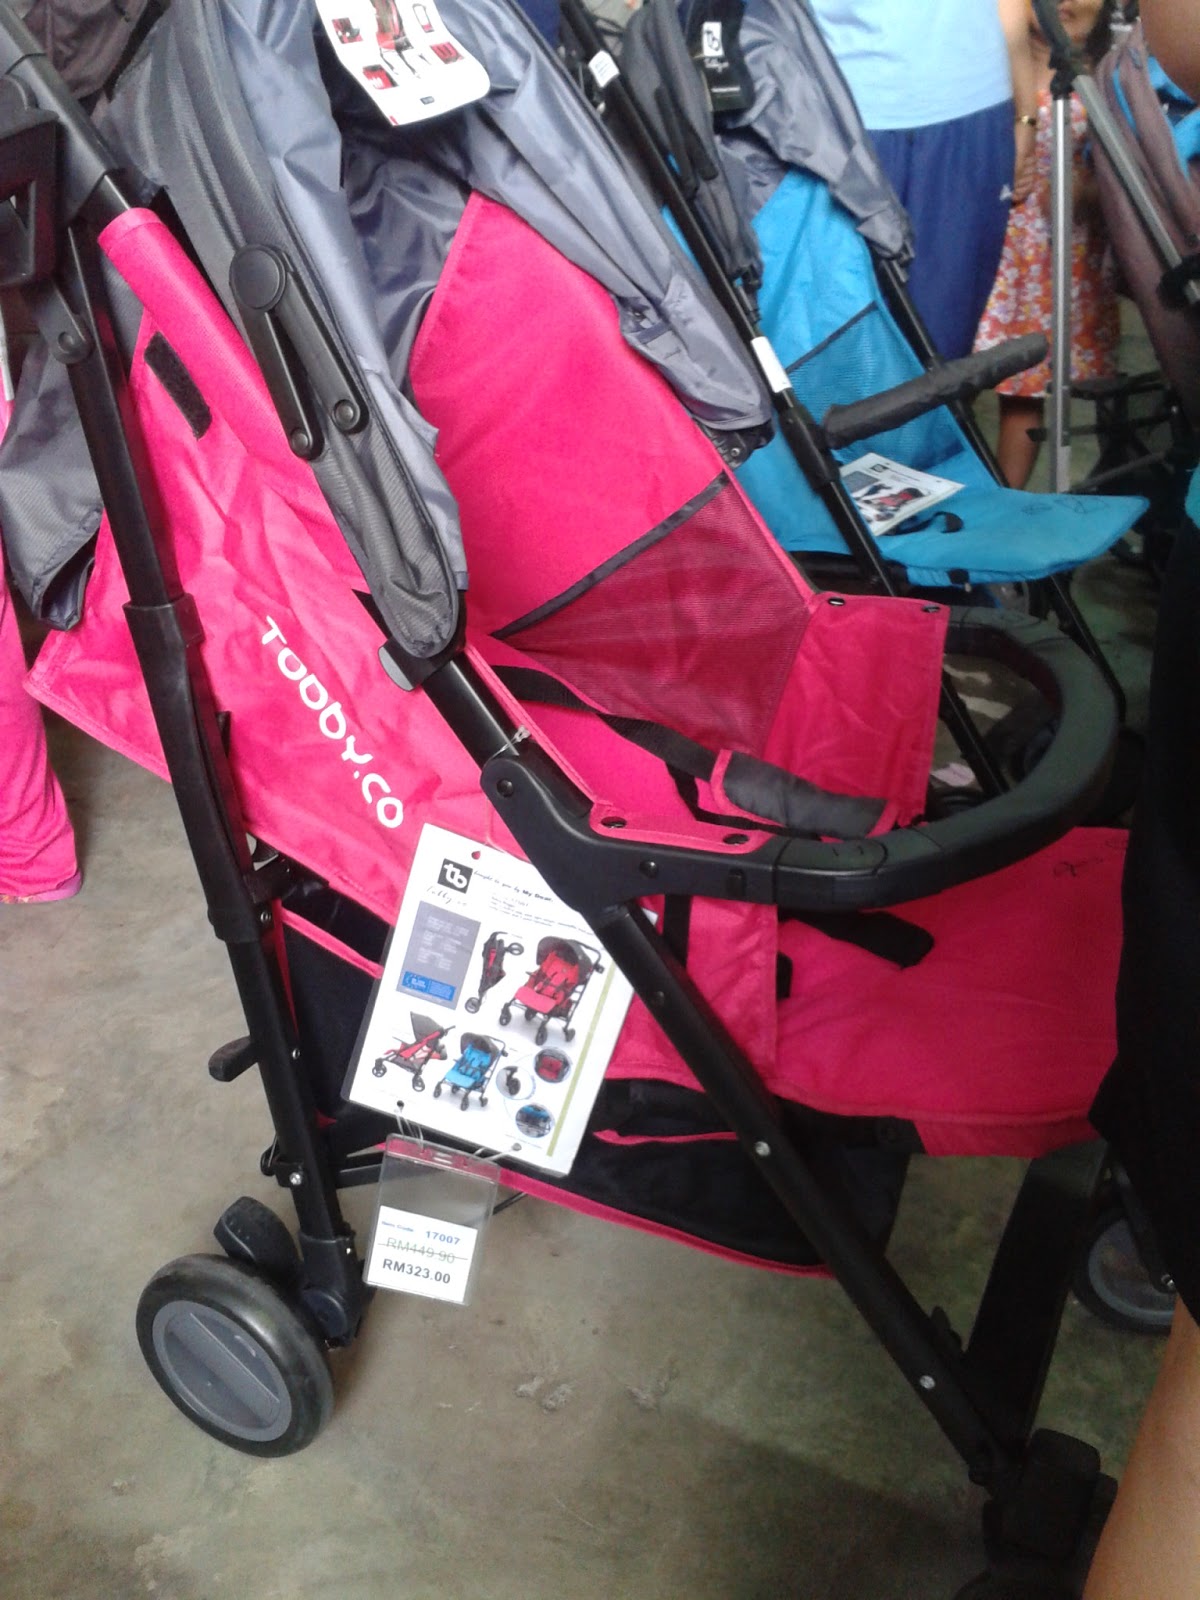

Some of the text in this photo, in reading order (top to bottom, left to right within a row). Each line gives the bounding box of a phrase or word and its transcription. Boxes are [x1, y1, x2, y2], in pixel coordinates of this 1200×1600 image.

[522, 889, 532, 897] My
[426, 1230, 461, 1246] 17007
[382, 1258, 451, 1284] RM323.00
